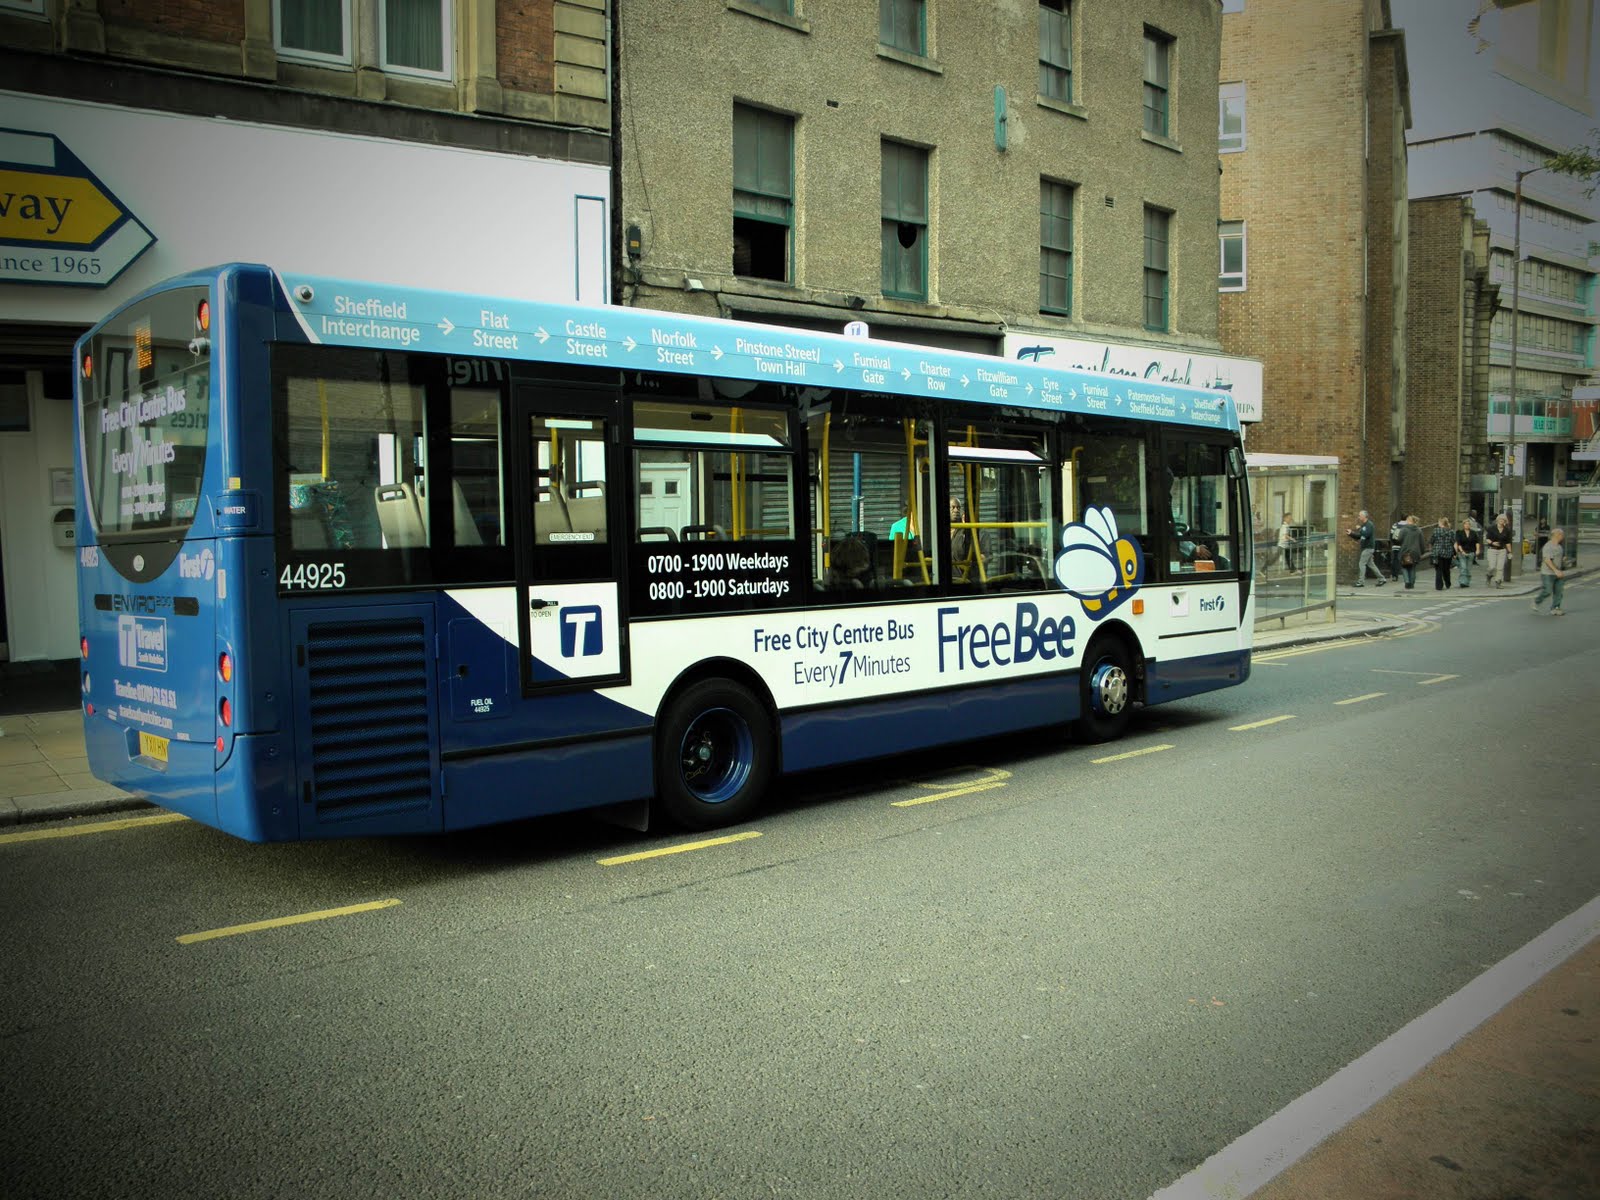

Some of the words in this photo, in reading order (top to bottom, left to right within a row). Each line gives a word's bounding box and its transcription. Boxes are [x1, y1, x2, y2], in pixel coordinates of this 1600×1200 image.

[0, 256, 43, 272] nce
[51, 256, 101, 275] 1965
[334, 296, 407, 320] Sheffield
[480, 310, 510, 330] Flat
[565, 319, 607, 339] Castle
[321, 316, 420, 346] Interchange
[472, 329, 518, 350] Street
[651, 328, 697, 349] Norfolk
[566, 339, 608, 358] Street
[656, 347, 695, 366] Street
[736, 338, 783, 359] Pinstone
[784, 346, 821, 364] Street/
[754, 357, 784, 375] Town
[785, 361, 806, 377] Hall
[862, 369, 885, 385] Gate
[920, 361, 951, 378] Charter
[977, 368, 1019, 386] Fitzwilliam
[927, 377, 946, 391] Row
[989, 385, 1008, 399] Gate
[1043, 377, 1060, 393] Eyre
[1041, 390, 1063, 405] Street
[1086, 396, 1107, 410] Street
[102, 408, 119, 433] Free
[136, 394, 167, 423] Centre
[166, 386, 186, 414] Bus
[648, 555, 681, 573] 0700
[691, 553, 724, 571] 1900
[726, 552, 789, 573] Weekdays
[279, 563, 346, 589] 44925
[649, 581, 684, 600] 0800
[694, 579, 726, 597] 1900
[728, 577, 790, 598] Saturdays
[1200, 598, 1215, 611] First
[135, 623, 164, 651] Travel
[753, 628, 792, 653] Free
[796, 625, 829, 654] City
[833, 621, 884, 646] Centre
[887, 619, 915, 641] Bus
[794, 660, 838, 688] Every
[838, 650, 853, 685] 7
[853, 656, 911, 678] Minutes
